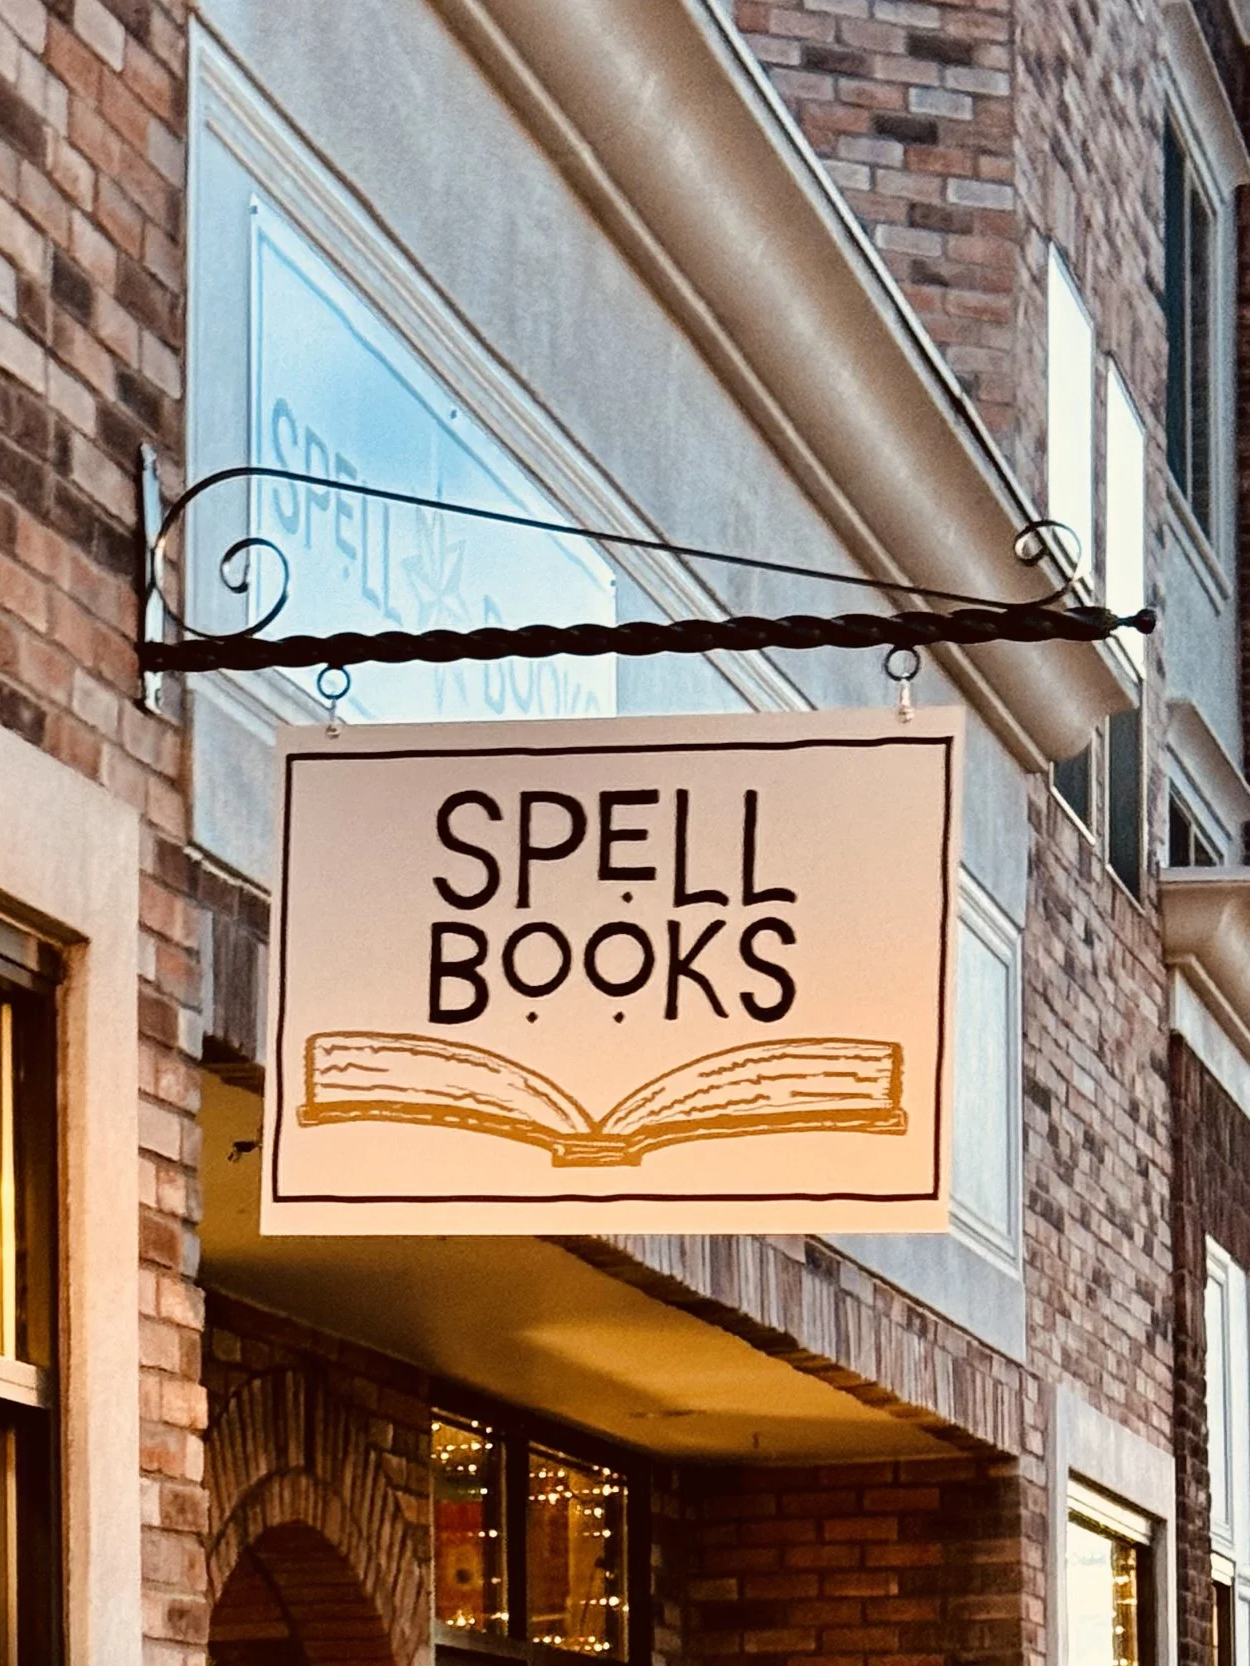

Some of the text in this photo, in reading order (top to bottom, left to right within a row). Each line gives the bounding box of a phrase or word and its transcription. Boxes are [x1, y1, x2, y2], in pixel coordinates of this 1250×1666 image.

[270, 396, 403, 628] SPELL
[432, 788, 798, 911] SPELL
[428, 916, 798, 1025] BOOKS
